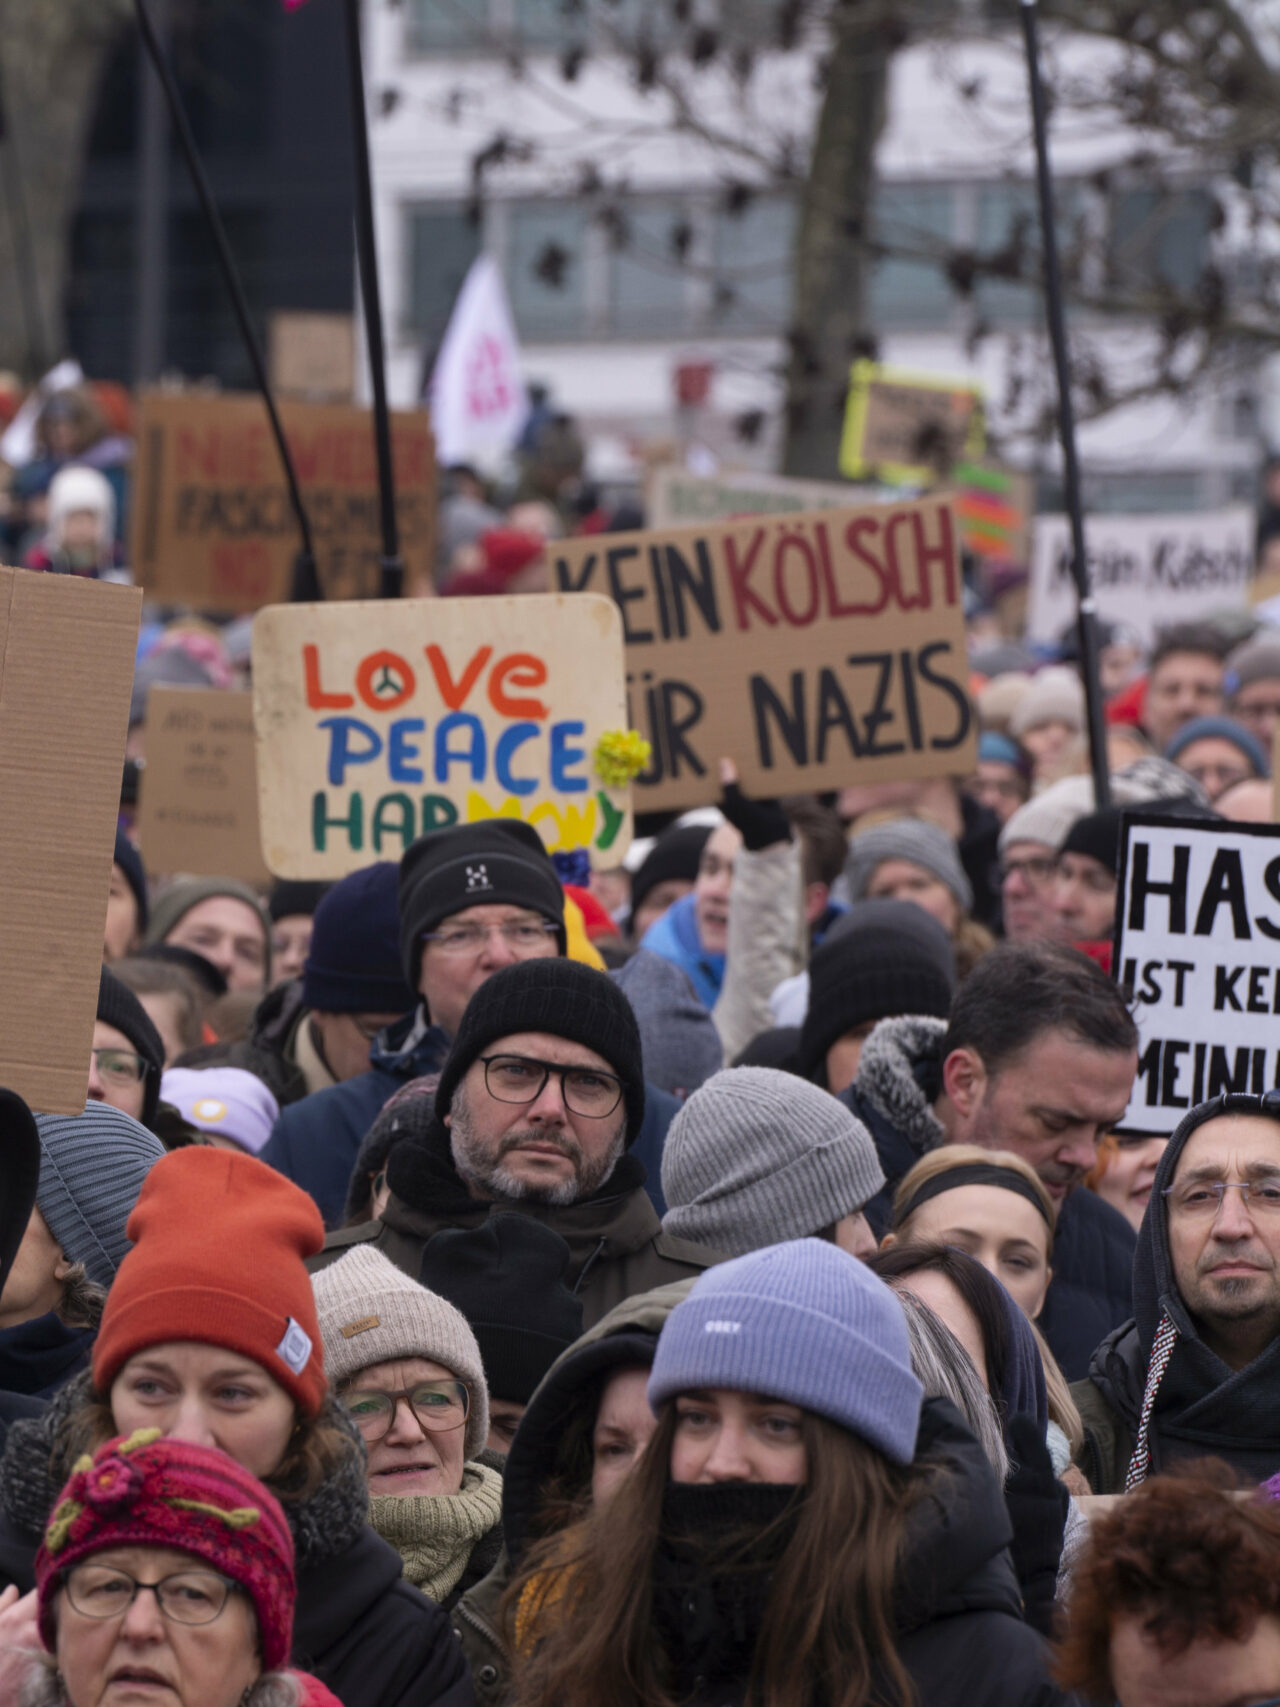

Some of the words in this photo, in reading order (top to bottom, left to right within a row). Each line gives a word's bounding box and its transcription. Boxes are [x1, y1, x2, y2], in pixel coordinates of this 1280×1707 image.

[723, 506, 958, 632] KÖLSCH
[317, 711, 590, 796] PEACE
[749, 640, 972, 770] NAZIS
[1122, 957, 1195, 1007] IST
